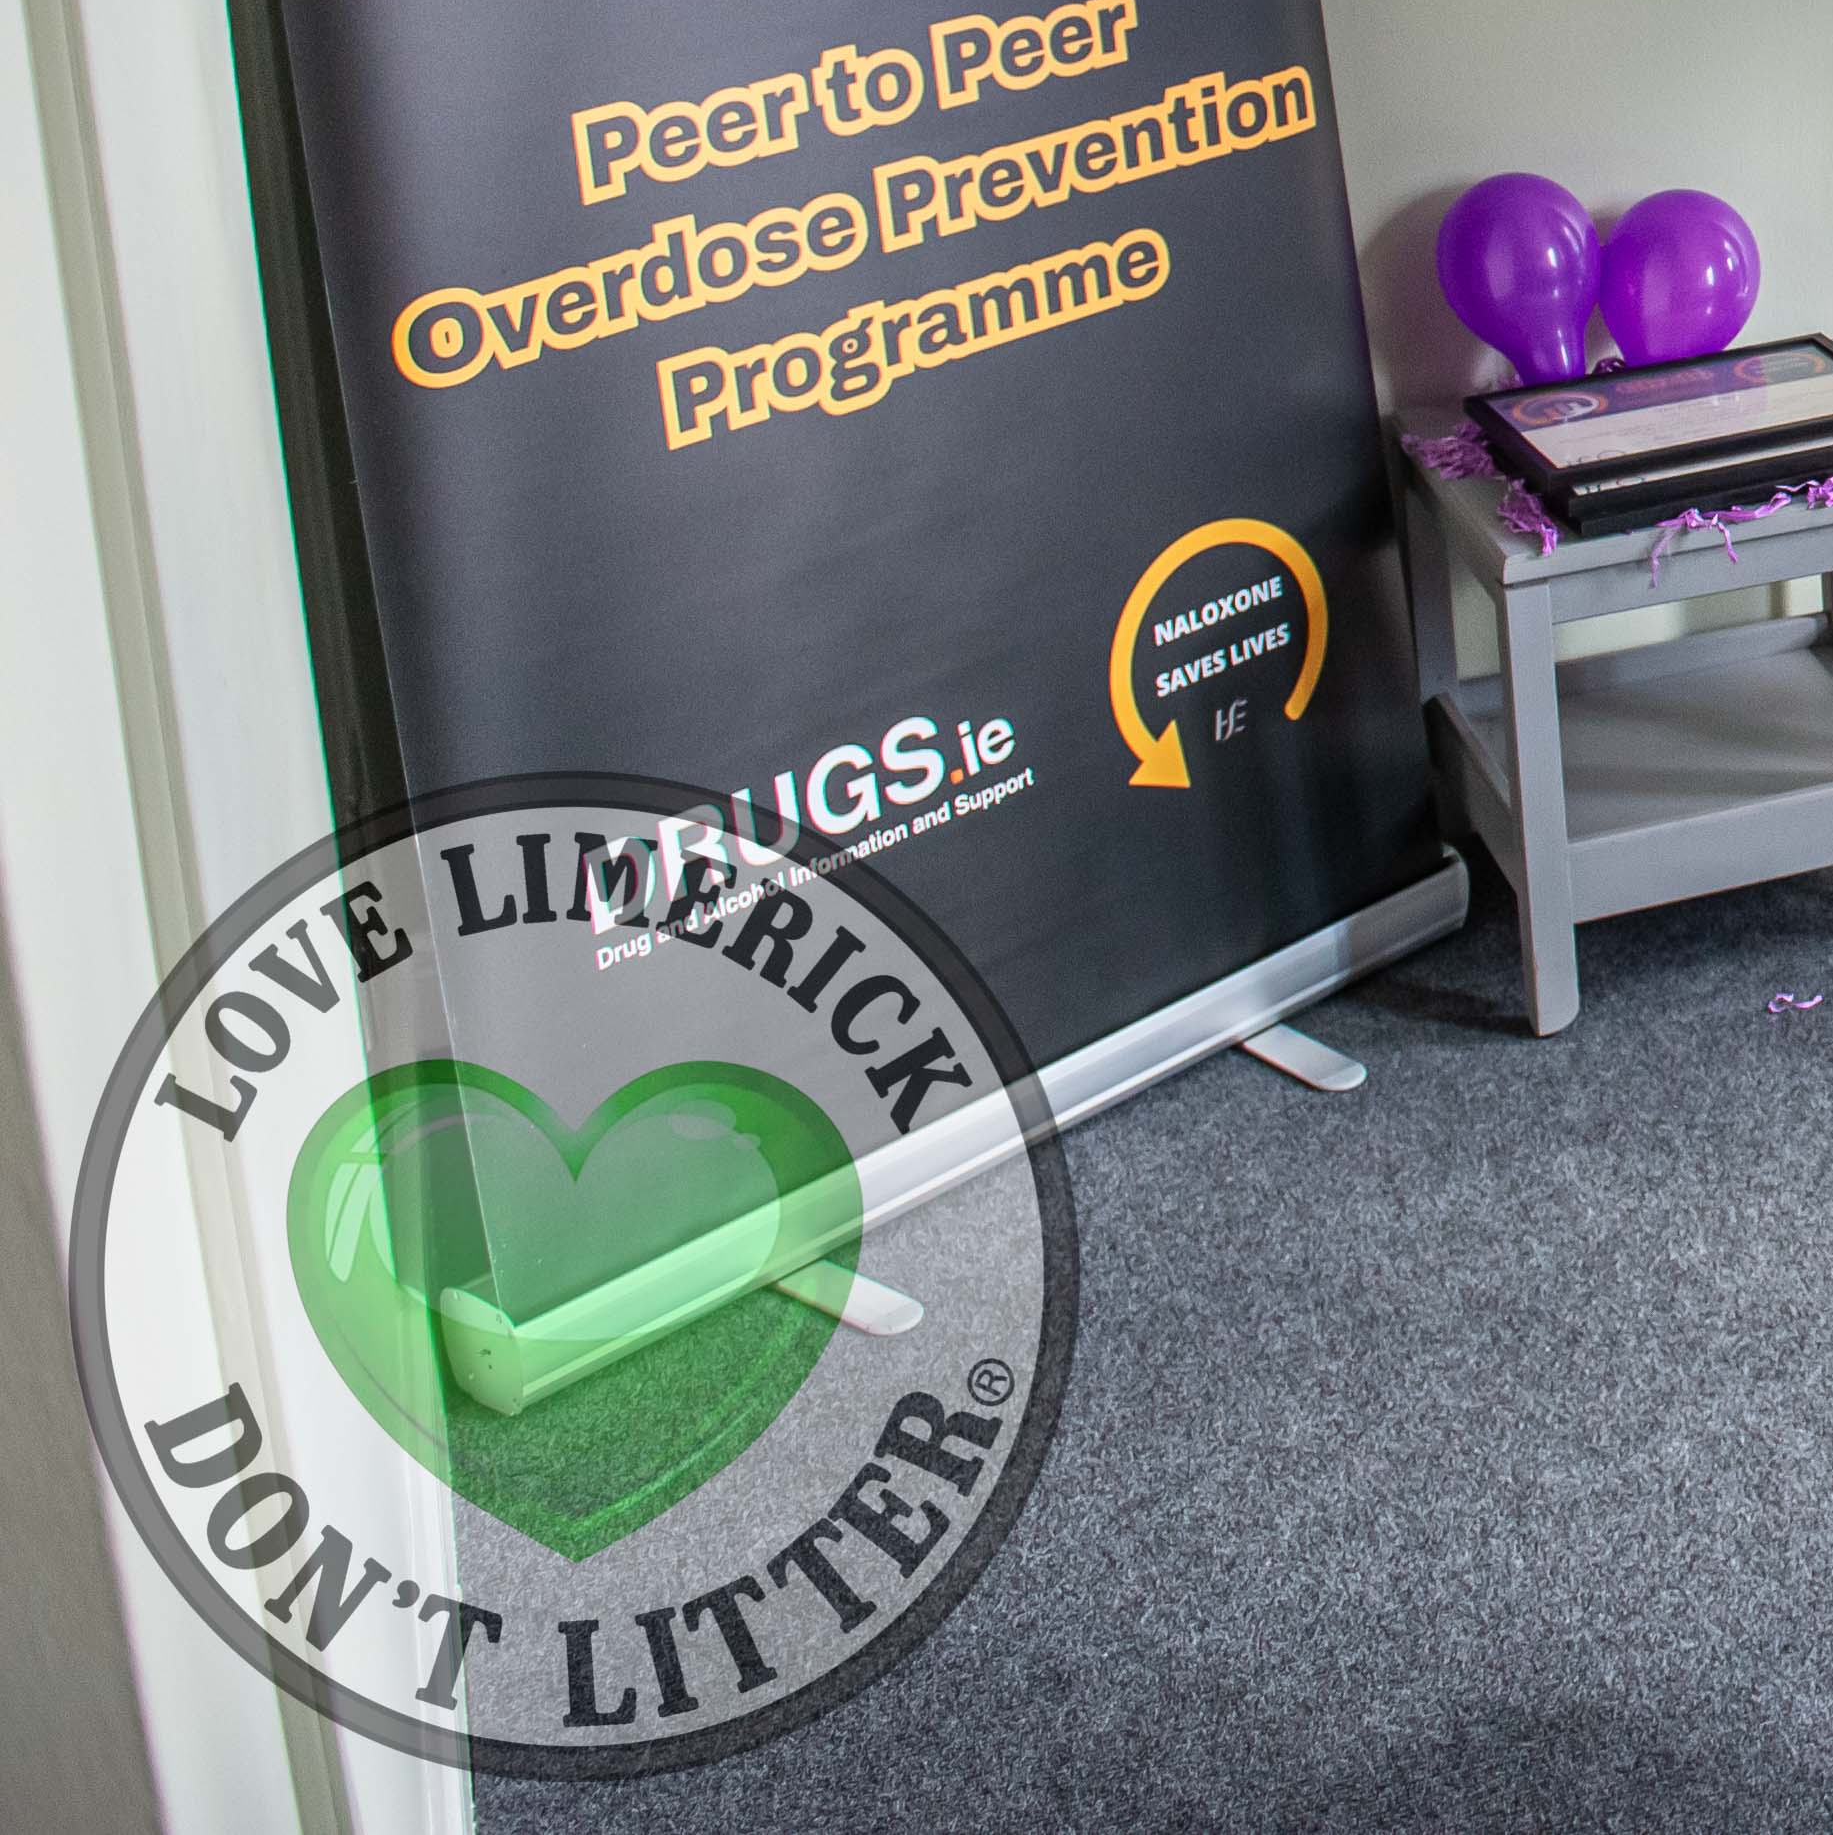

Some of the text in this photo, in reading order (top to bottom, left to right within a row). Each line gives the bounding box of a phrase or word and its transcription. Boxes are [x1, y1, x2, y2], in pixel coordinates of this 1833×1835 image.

[572, 72, 808, 204] Peer
[813, 45, 923, 134] to
[392, 66, 1317, 388] Overdose Prevention
[655, 228, 1170, 451] Programme
[1154, 575, 1283, 646] NALOXONE
[1156, 623, 1291, 697] SAVES LIVES
[594, 932, 653, 973] Drug
[702, 873, 786, 925] Alcohol
[789, 822, 909, 888] Information
[912, 801, 952, 836] and
[955, 766, 1035, 817] Support
